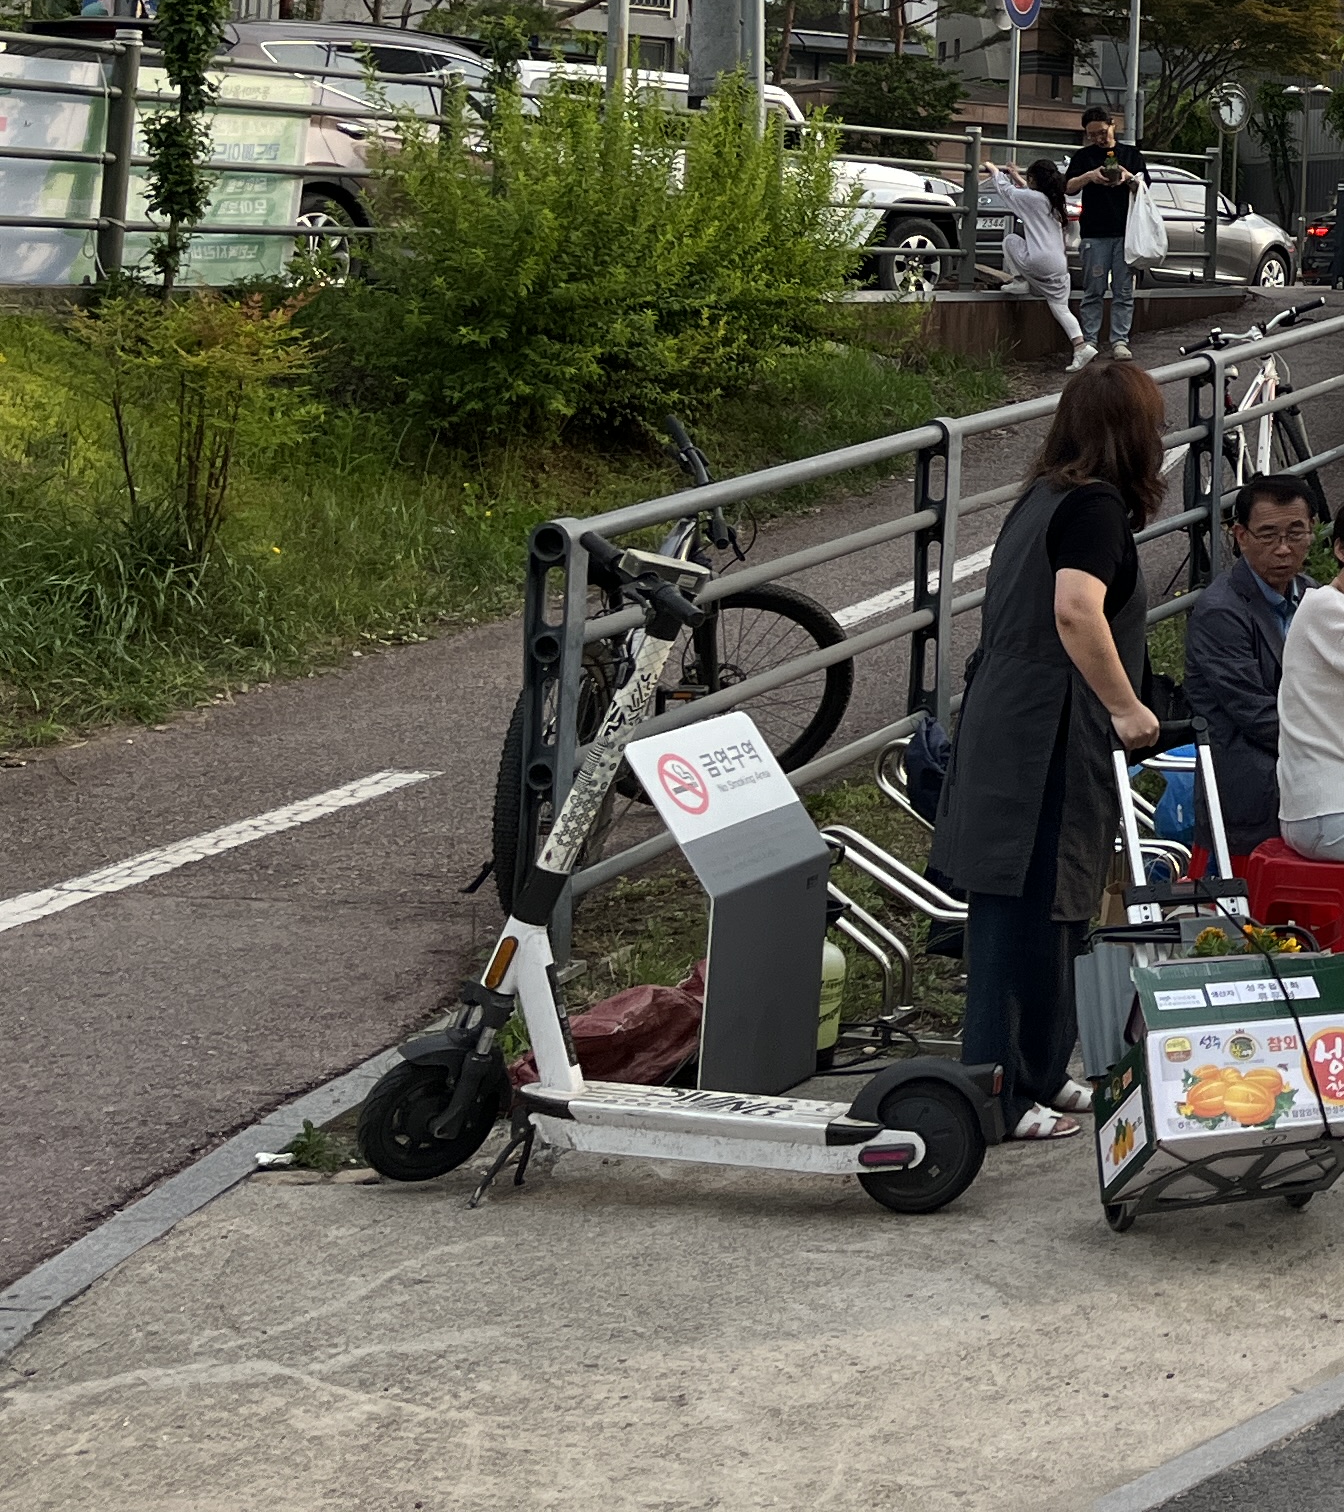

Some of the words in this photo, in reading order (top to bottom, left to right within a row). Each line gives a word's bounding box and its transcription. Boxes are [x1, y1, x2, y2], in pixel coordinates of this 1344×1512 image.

[698, 739, 763, 778] 금연구역
[716, 784, 729, 793] No
[727, 776, 757, 790] Smoking
[755, 769, 772, 780] Area
[1266, 1035, 1298, 1053] 참외
